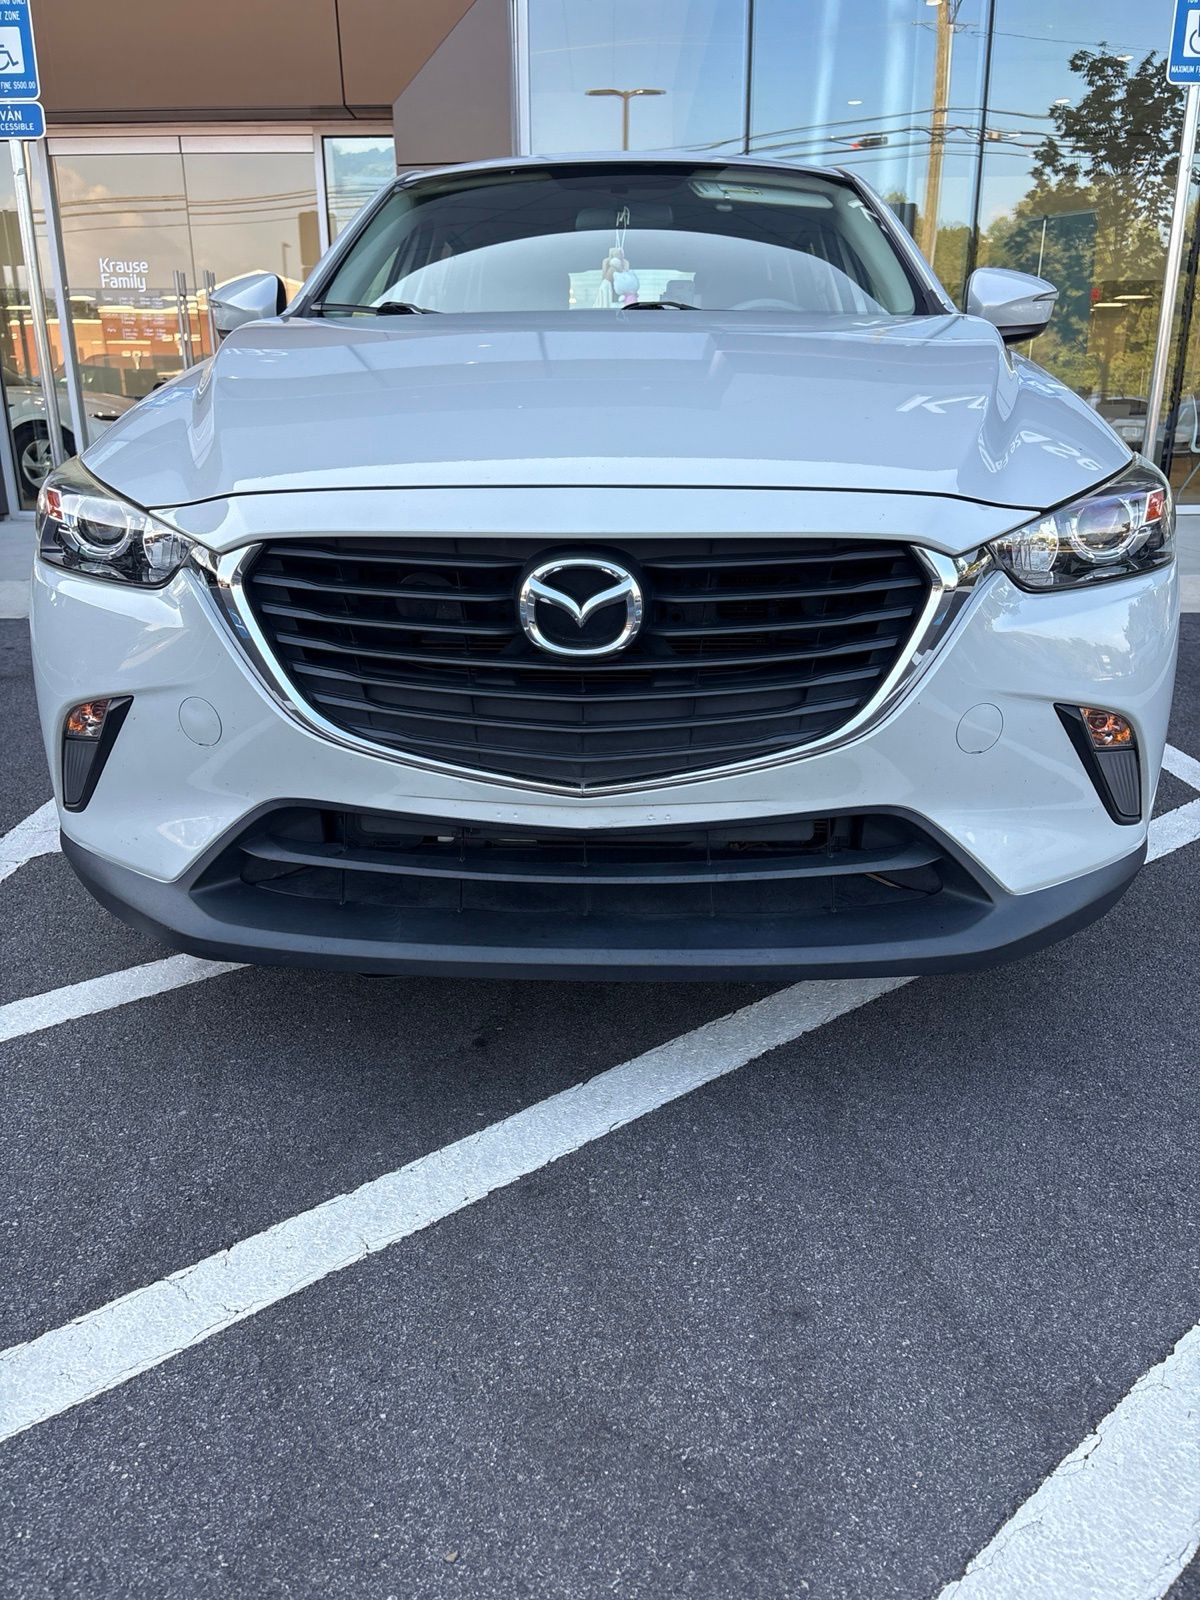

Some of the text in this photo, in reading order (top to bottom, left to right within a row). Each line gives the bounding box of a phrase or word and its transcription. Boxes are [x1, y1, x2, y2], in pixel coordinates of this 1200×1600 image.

[5, 11, 20, 20] ZONE
[1171, 65, 1194, 73] MAXIMUM
[13, 81, 35, 89] $500.00
[0, 110, 22, 121] VAN
[99, 258, 148, 273] Krause
[101, 273, 146, 292] Family
